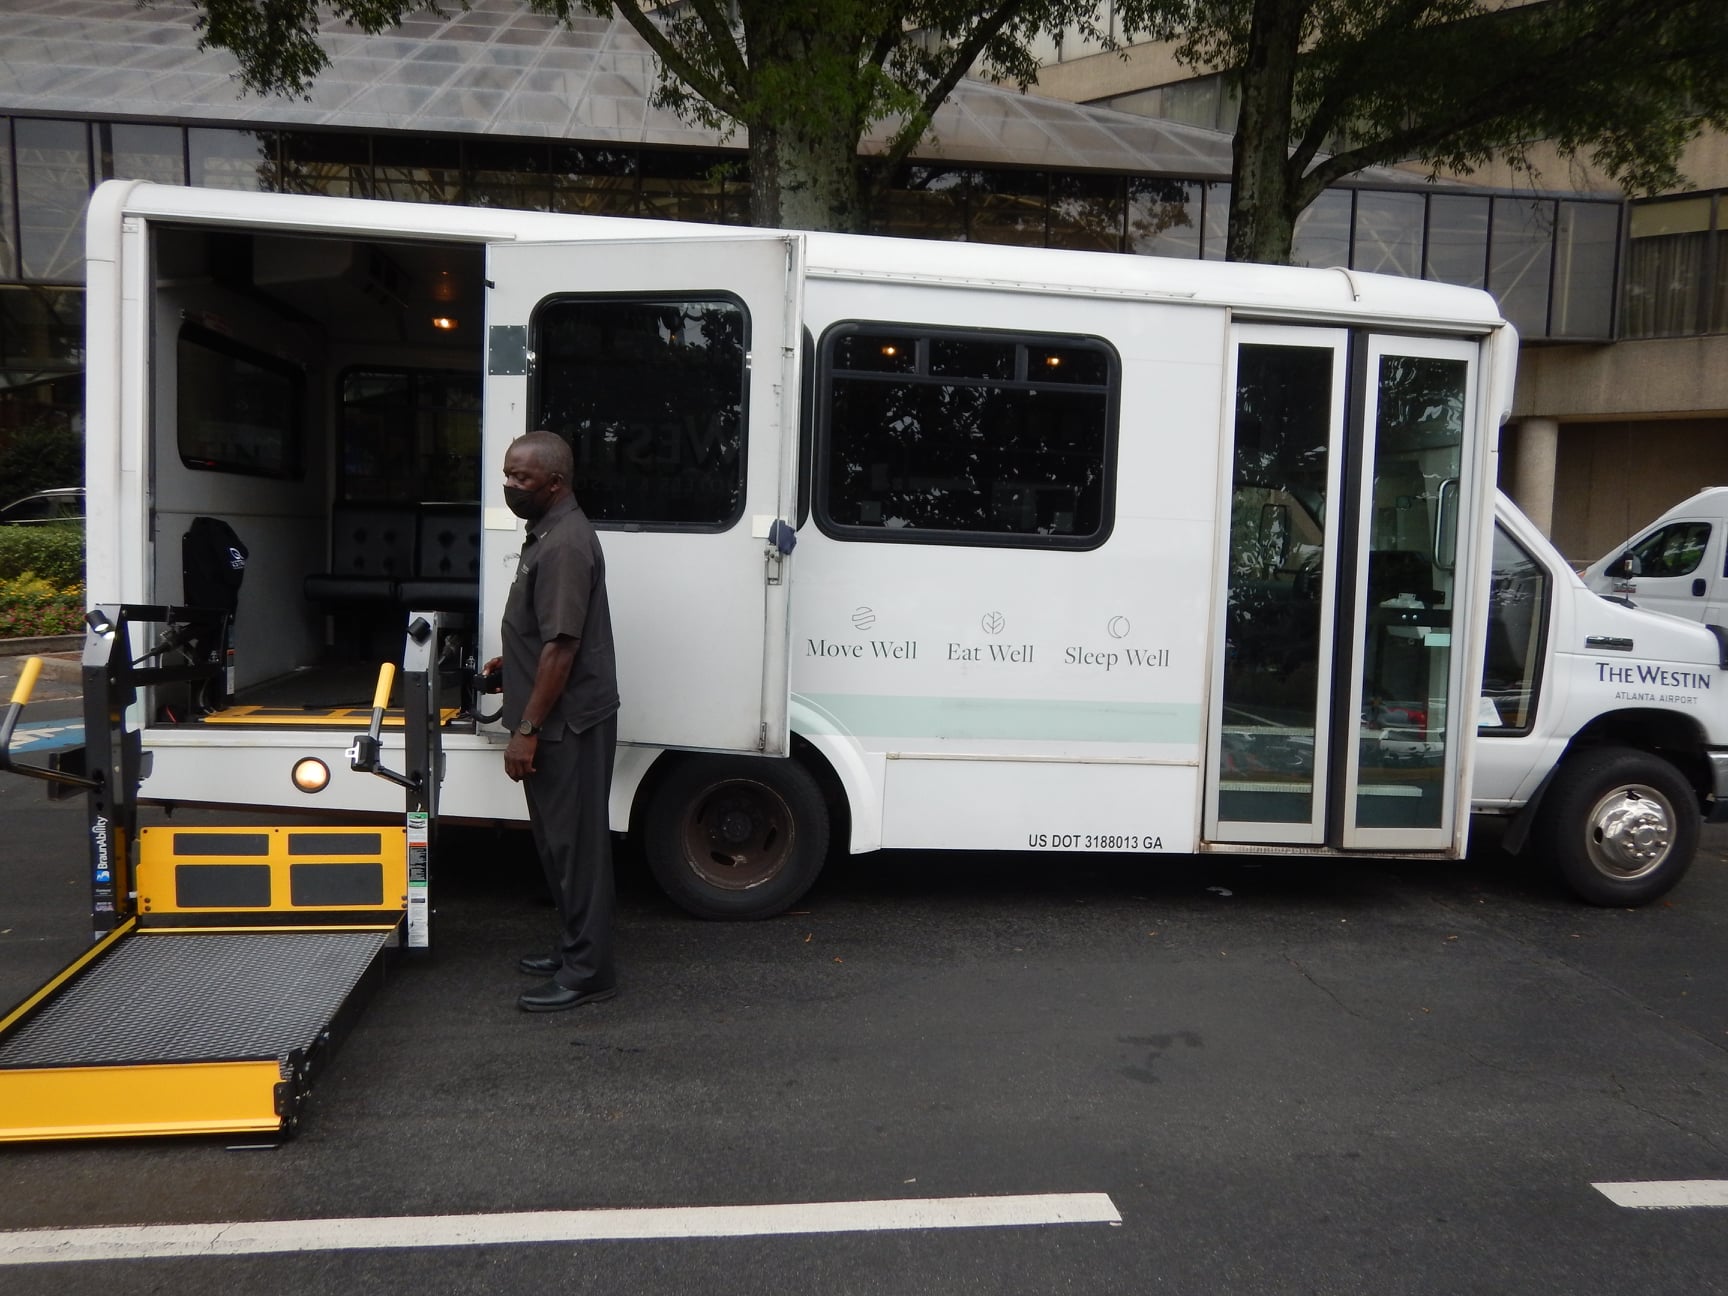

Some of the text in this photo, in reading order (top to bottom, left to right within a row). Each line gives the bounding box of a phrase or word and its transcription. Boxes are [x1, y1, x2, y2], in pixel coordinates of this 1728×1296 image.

[806, 638, 918, 660] Move Well
[947, 642, 1035, 663] Eat Well
[1064, 646, 1170, 671] Sleep Well
[1595, 662, 1712, 690] THE WESTIN
[1615, 691, 1698, 705] ATLANTA AIRPORT
[91, 815, 109, 870] BraunAbility
[1028, 834, 1164, 849] US DOT 3188013 GA
